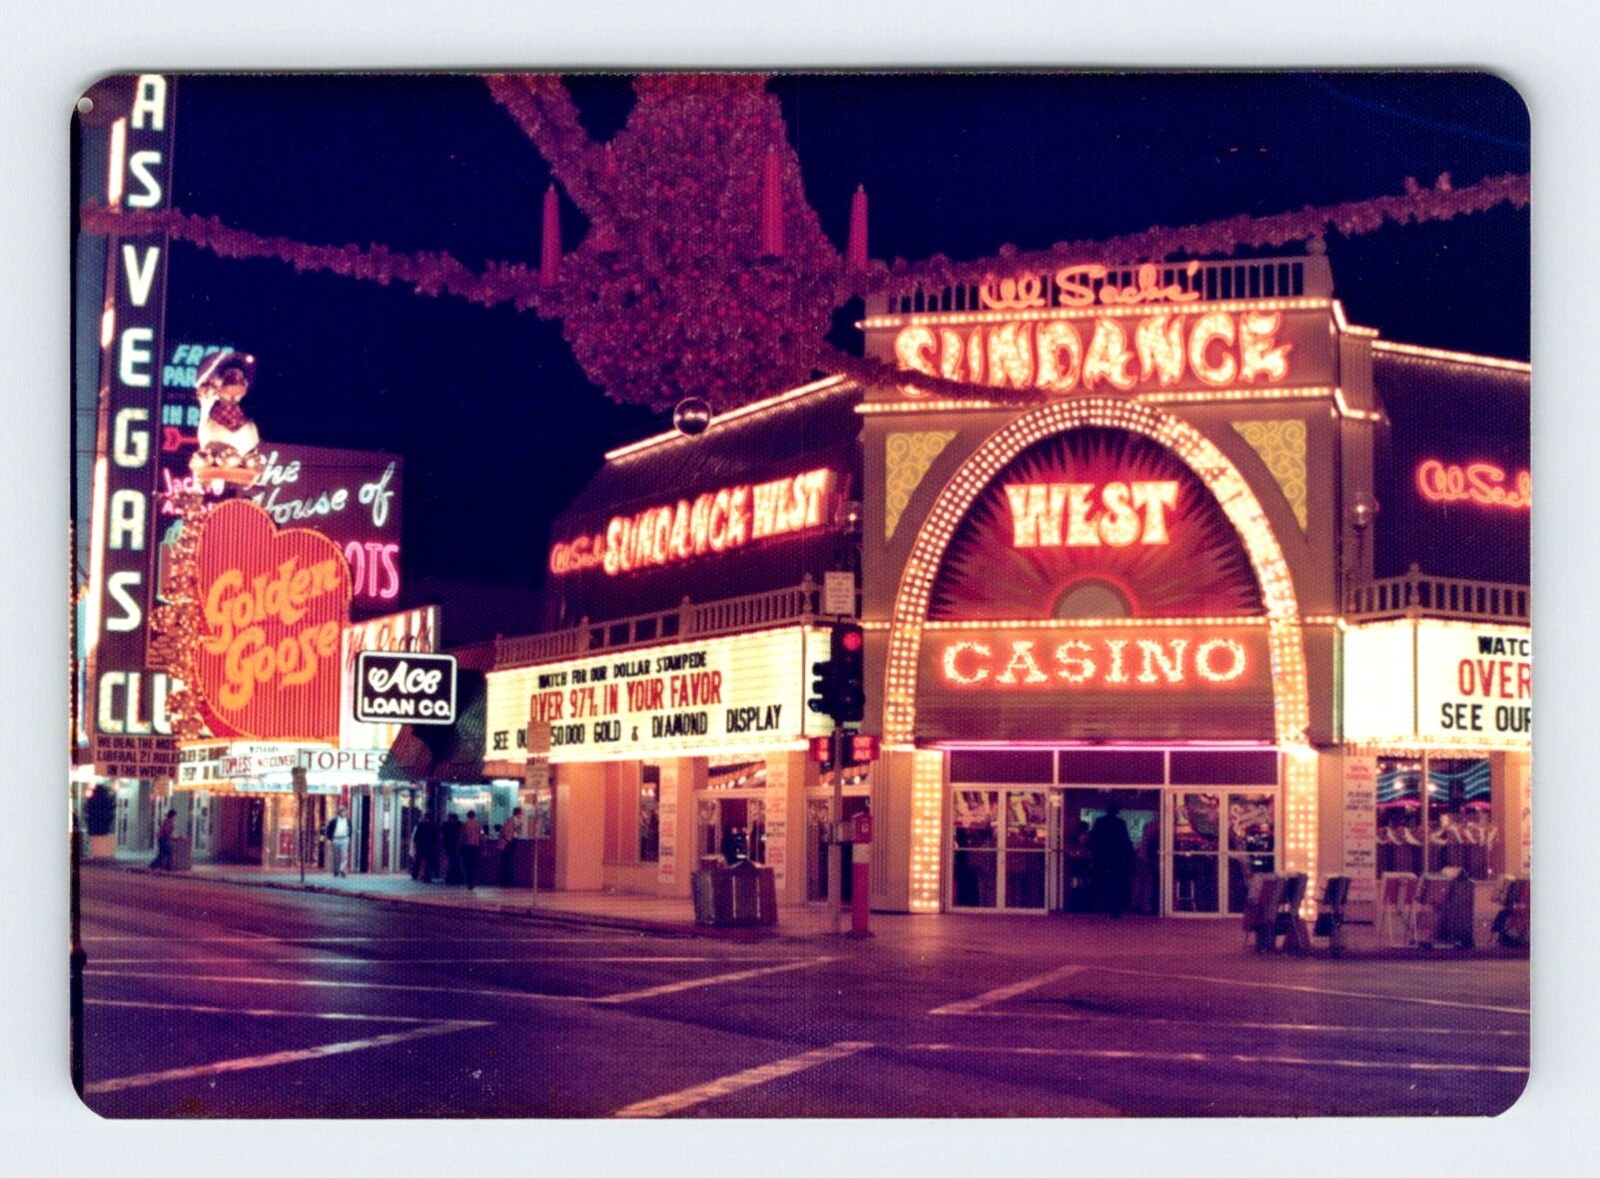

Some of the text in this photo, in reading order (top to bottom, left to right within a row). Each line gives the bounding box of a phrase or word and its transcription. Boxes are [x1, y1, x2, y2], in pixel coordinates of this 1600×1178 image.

[894, 310, 1293, 398] SUNDANCE
[105, 244, 160, 632] VEGAS
[162, 404, 183, 427] IN
[249, 450, 301, 488] he
[358, 461, 396, 527] of
[1003, 479, 1179, 548] WEST
[603, 484, 750, 576] SUNDANCE
[751, 467, 832, 539] WEST
[337, 540, 400, 599] OTS
[203, 552, 341, 655] Golden
[219, 620, 339, 711] Goose
[368, 660, 442, 694] Ace
[539, 650, 707, 690] WATCH FOR OUR DOLLAR STAMPEDE
[941, 637, 1247, 685] CASINO
[1458, 658, 1531, 700] OVER
[363, 696, 415, 716] LOAN
[530, 686, 563, 722] OVER
[603, 683, 619, 715] IN
[627, 677, 664, 713] YOUR
[670, 669, 722, 706] FAVOR
[1440, 701, 1483, 732] SEE
[493, 730, 509, 750] SEE
[516, 729, 528, 749] OU
[593, 719, 621, 743] GOLD
[631, 725, 639, 742] &
[652, 710, 708, 738] DIAMOND
[726, 704, 782, 734] DISPLAY
[153, 752, 178, 764] RULE
